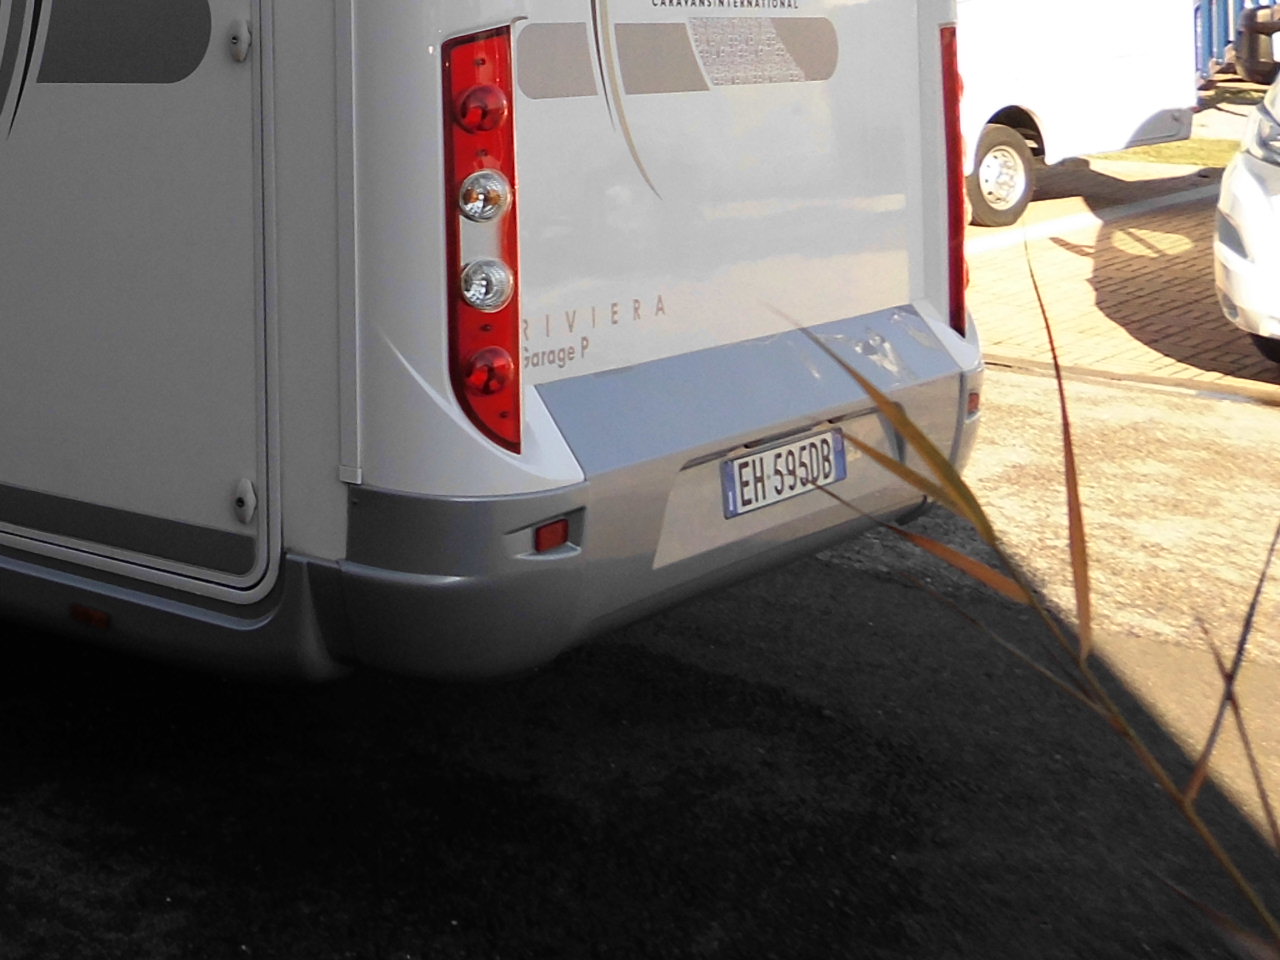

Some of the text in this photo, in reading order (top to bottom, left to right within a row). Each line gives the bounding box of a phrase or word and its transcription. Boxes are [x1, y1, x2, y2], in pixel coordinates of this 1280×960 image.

[522, 294, 666, 341] RIVIERA
[580, 336, 590, 359] P
[738, 456, 767, 507] EH
